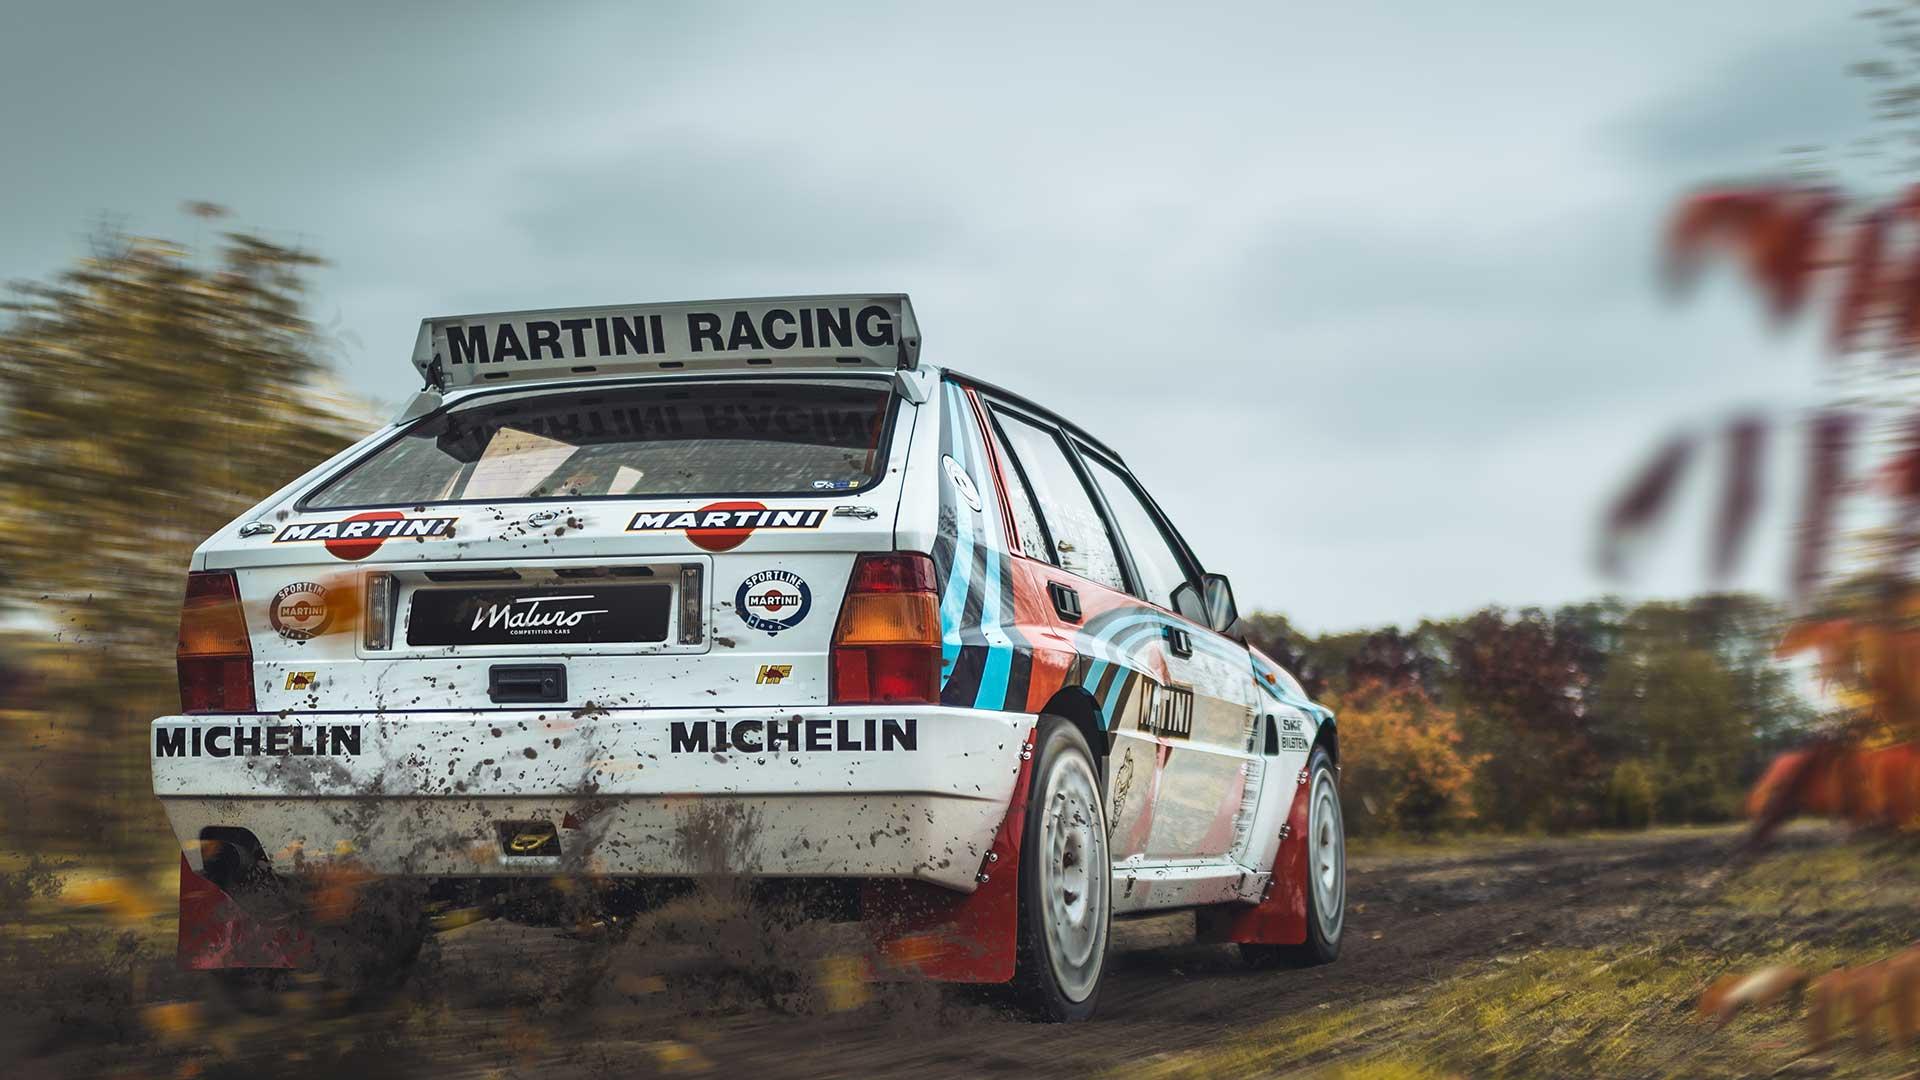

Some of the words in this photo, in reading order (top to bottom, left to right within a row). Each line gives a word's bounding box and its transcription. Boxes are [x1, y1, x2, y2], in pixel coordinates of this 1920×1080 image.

[446, 314, 666, 365] MARTINI
[687, 305, 895, 353] RACING
[280, 519, 451, 541] MARTINI
[632, 509, 821, 530] MARTINI
[745, 571, 804, 589] SPORTLINE
[278, 582, 329, 600] SPORTLINE
[750, 596, 797, 606] MARTINI
[281, 606, 323, 617] MARTINI
[471, 594, 609, 632] Maturo
[155, 725, 362, 758] MICHELIN
[670, 718, 918, 754] MICHELIN
[1281, 736, 1309, 750] BILSTEIN
